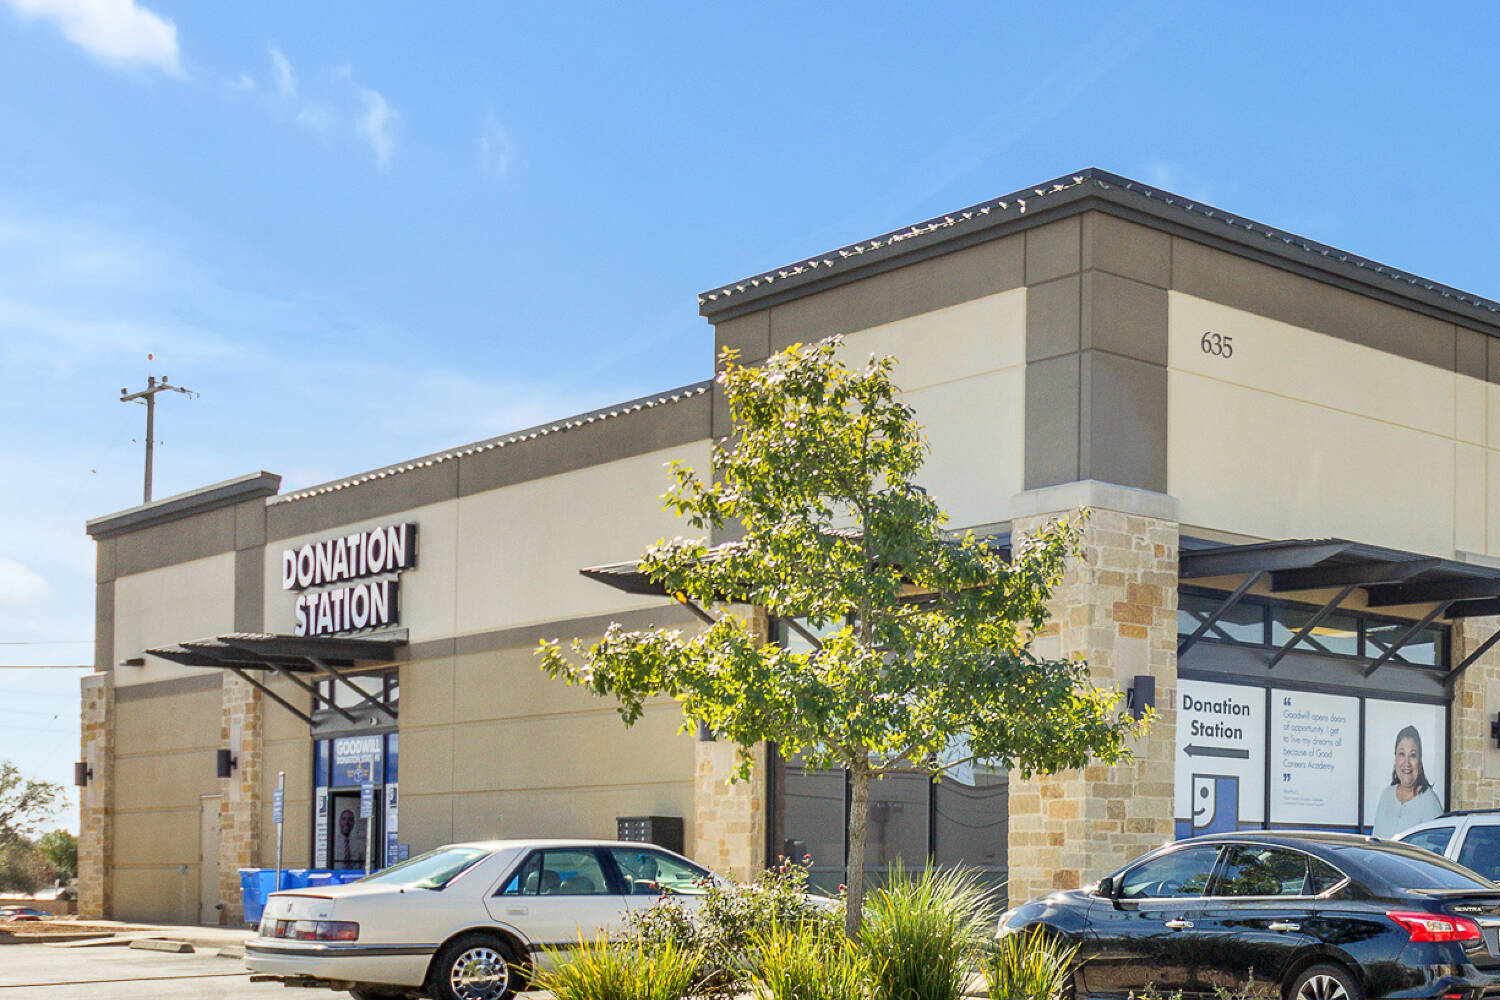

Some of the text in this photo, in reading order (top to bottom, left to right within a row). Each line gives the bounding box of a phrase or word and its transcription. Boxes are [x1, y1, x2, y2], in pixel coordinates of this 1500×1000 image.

[1201, 332, 1232, 358] 635
[283, 523, 408, 590] DONATION
[294, 580, 390, 637] STATION
[1183, 694, 1250, 716] Donation
[1283, 709, 1310, 720] Goodwill
[1191, 719, 1243, 740] Station
[336, 738, 380, 756] GOODWILL
